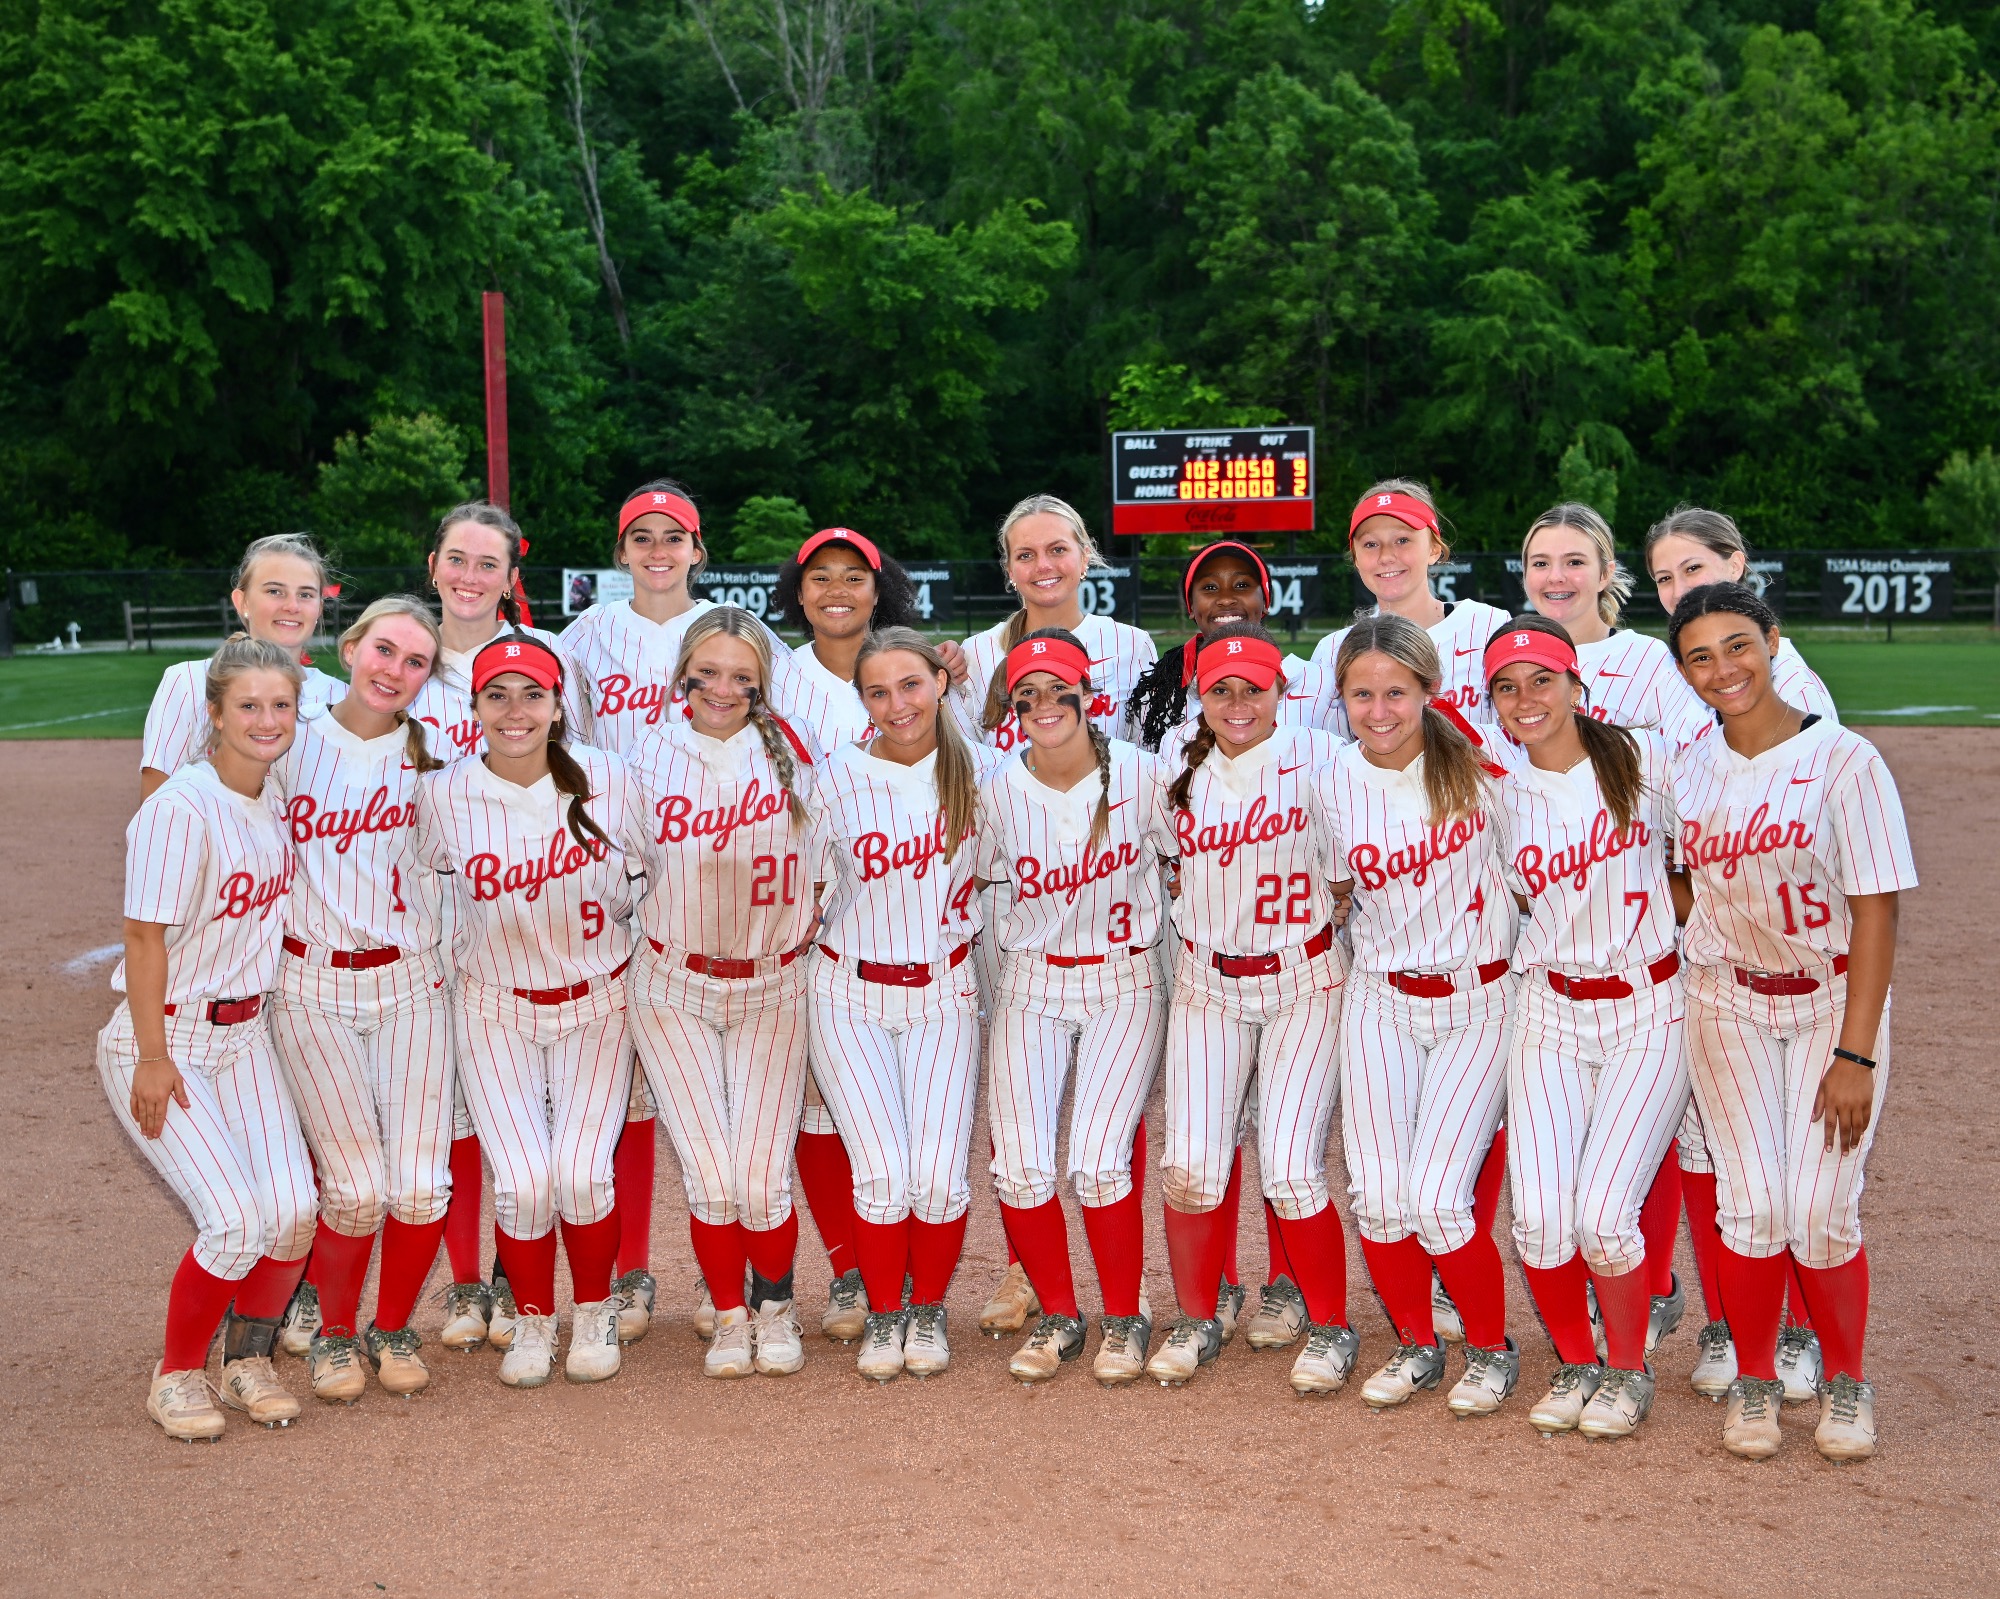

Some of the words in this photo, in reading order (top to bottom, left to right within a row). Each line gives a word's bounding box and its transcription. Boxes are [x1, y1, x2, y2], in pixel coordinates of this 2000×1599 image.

[1124, 438, 1157, 450] BALL
[1185, 435, 1233, 448] STRIKE
[1259, 434, 1288, 446] OUT
[1128, 466, 1178, 479] GUEST
[1134, 484, 1178, 498] HOME
[652, 494, 667, 504] B
[1377, 495, 1392, 507] B
[723, 571, 749, 584] State
[1825, 559, 1858, 572] TSSAA
[1860, 559, 1889, 572] State
[1889, 558, 1951, 575] Champions
[1078, 580, 1116, 616] 03
[1841, 574, 1932, 613] 2013
[505, 645, 521, 658] B
[1031, 642, 1047, 655] B
[1226, 641, 1243, 655] B
[1513, 633, 1530, 648] B
[287, 785, 416, 855] Baylor
[656, 778, 793, 852] Baylor
[1175, 795, 1308, 868] Baylor
[1348, 808, 1487, 892] Baylor
[1514, 808, 1650, 899] Baylor
[1680, 802, 1814, 879] Baylor
[465, 827, 609, 902] Baylor
[751, 853, 798, 907] 20
[1015, 836, 1140, 906] Baylor
[391, 863, 407, 913] 1
[1254, 872, 1311, 925] 22
[1776, 881, 1831, 936] 15
[580, 901, 605, 941] 9
[1107, 901, 1133, 943] 3
[1623, 889, 1650, 946] 7
